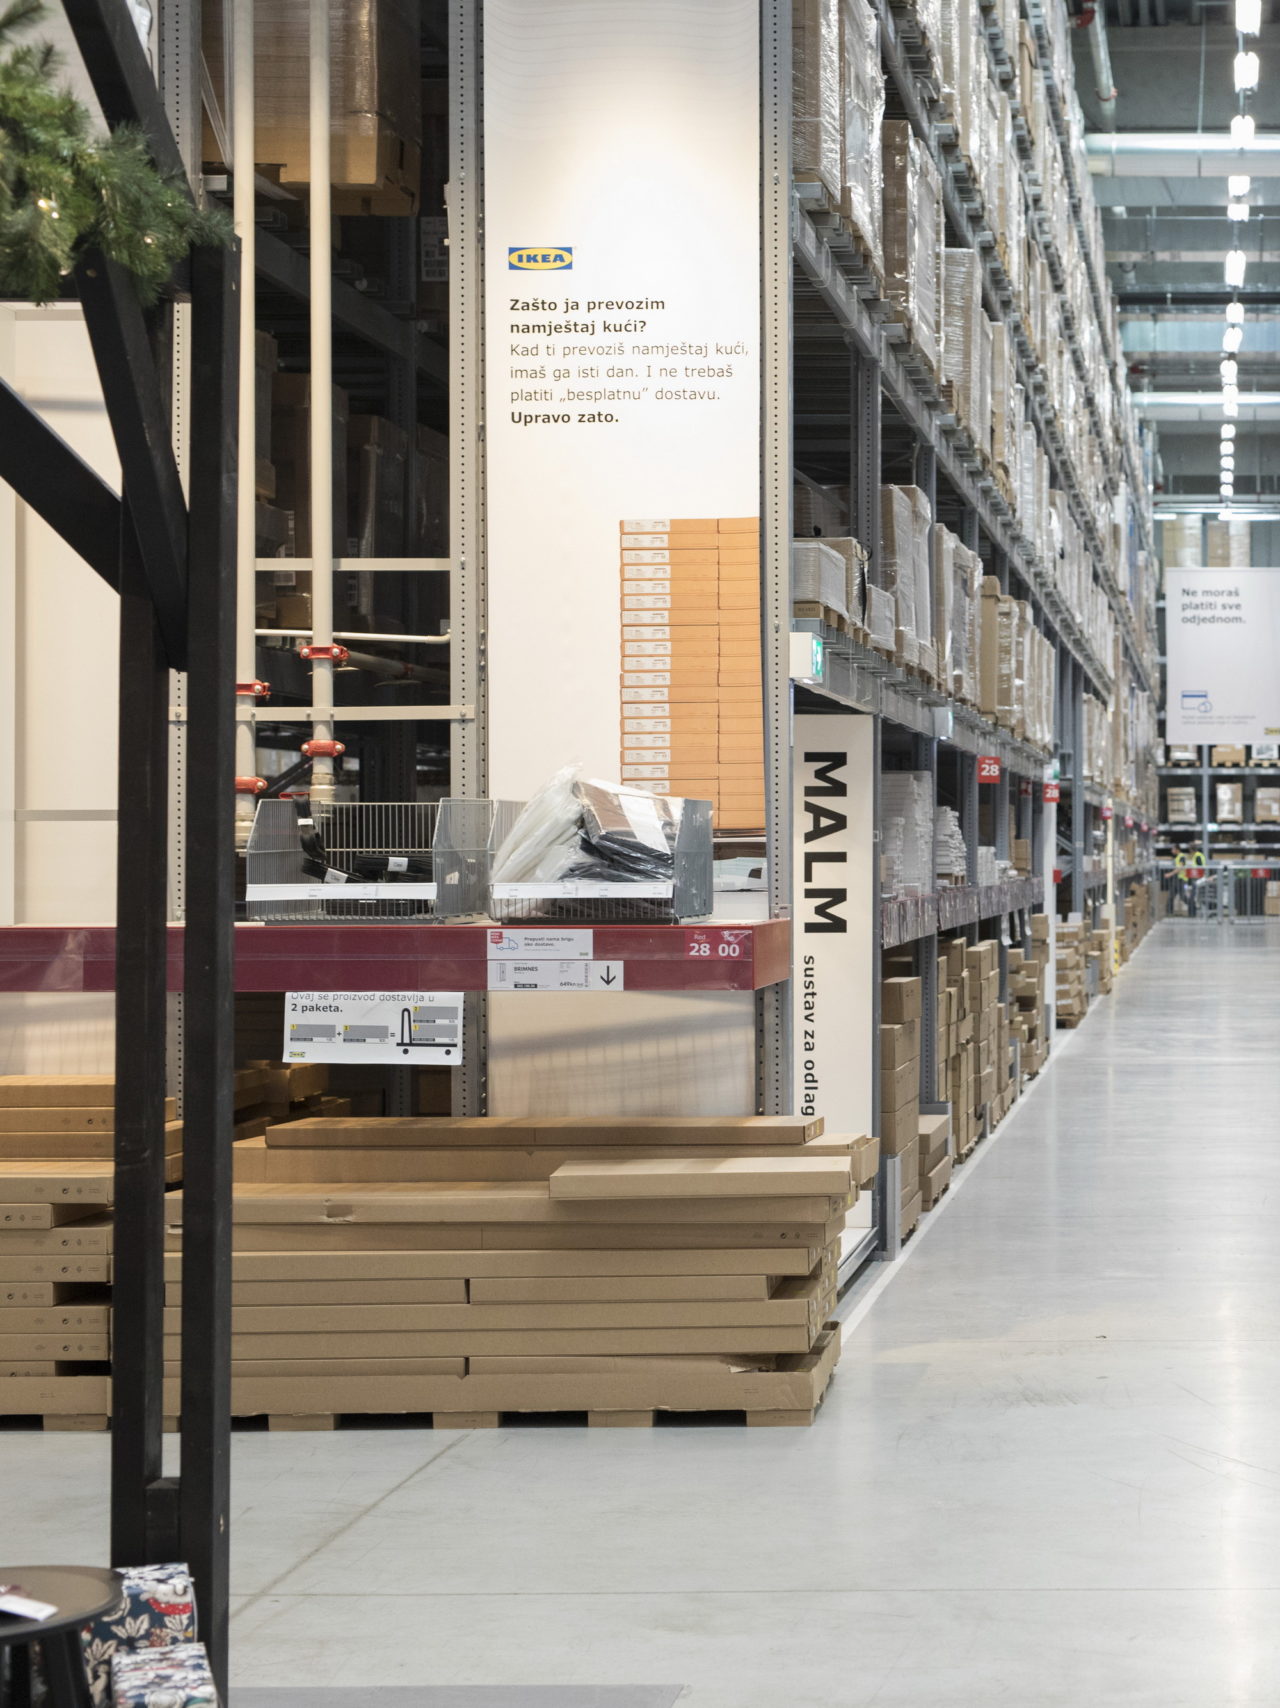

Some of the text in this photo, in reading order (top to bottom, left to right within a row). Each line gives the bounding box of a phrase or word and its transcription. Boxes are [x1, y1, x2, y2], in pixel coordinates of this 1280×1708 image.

[517, 254, 566, 263] IKEA
[509, 298, 665, 313] Zašto ja prevozim
[510, 320, 647, 336] namještaj kući?
[510, 341, 749, 358] Kad ti prevoziš namještaj kući,
[510, 365, 734, 381] imaš ga isti dan. I ne trebaš
[510, 389, 553, 404] platiti
[654, 388, 721, 400] dostavu.
[510, 412, 619, 426] Upravo zato.
[1181, 588, 1241, 597] Ne moraš
[1180, 602, 1217, 612] platiti
[1180, 615, 1246, 626] odjednom.
[981, 764, 1000, 776] 28
[1045, 789, 1060, 798] 28
[804, 751, 848, 934] MALM
[689, 943, 740, 957] 28 00
[318, 992, 329, 1001] se
[332, 992, 376, 1003] proizvod
[378, 993, 425, 1004] dostavlja
[428, 995, 435, 1003] u
[291, 1003, 343, 1013] 2 paketa.
[801, 955, 819, 1117] sustav za odlag
